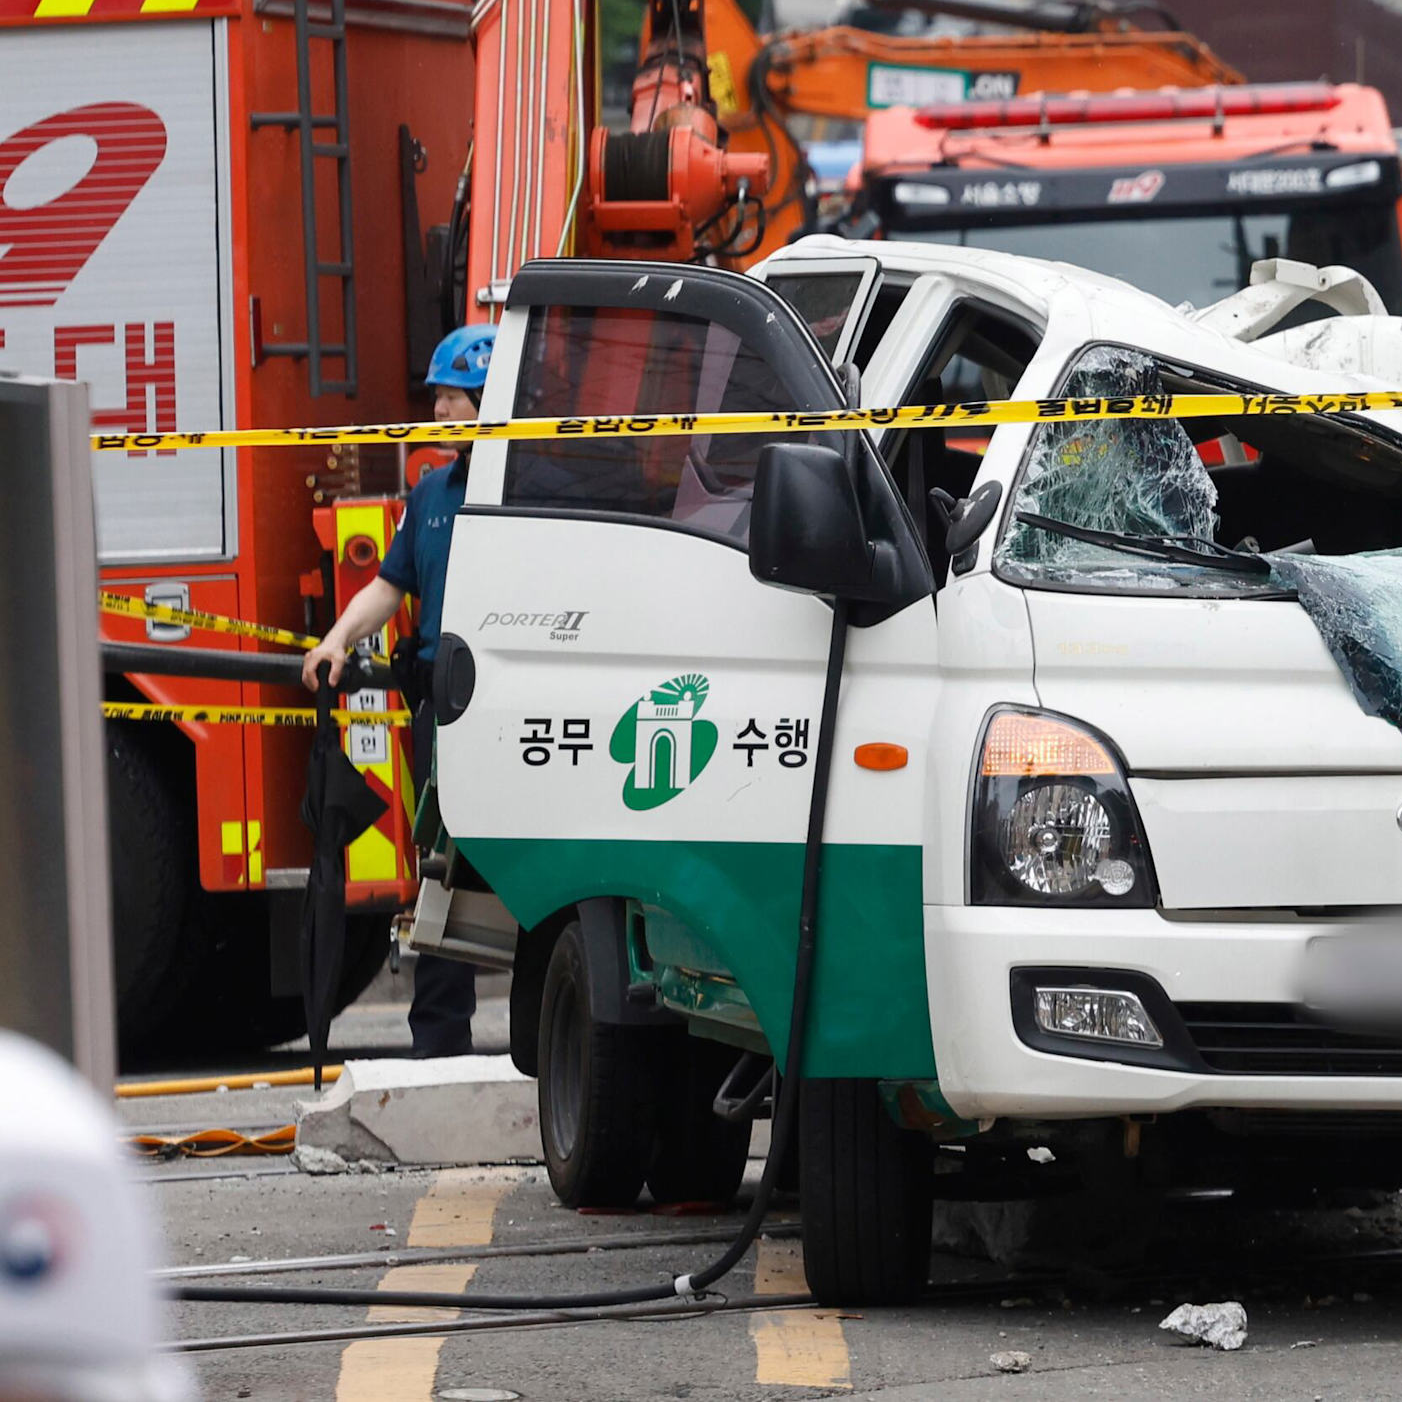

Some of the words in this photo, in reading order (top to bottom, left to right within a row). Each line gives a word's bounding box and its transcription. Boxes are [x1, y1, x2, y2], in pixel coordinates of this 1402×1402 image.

[549, 631, 579, 642] Super
[519, 718, 594, 767] 공무
[732, 717, 810, 769] 수행
